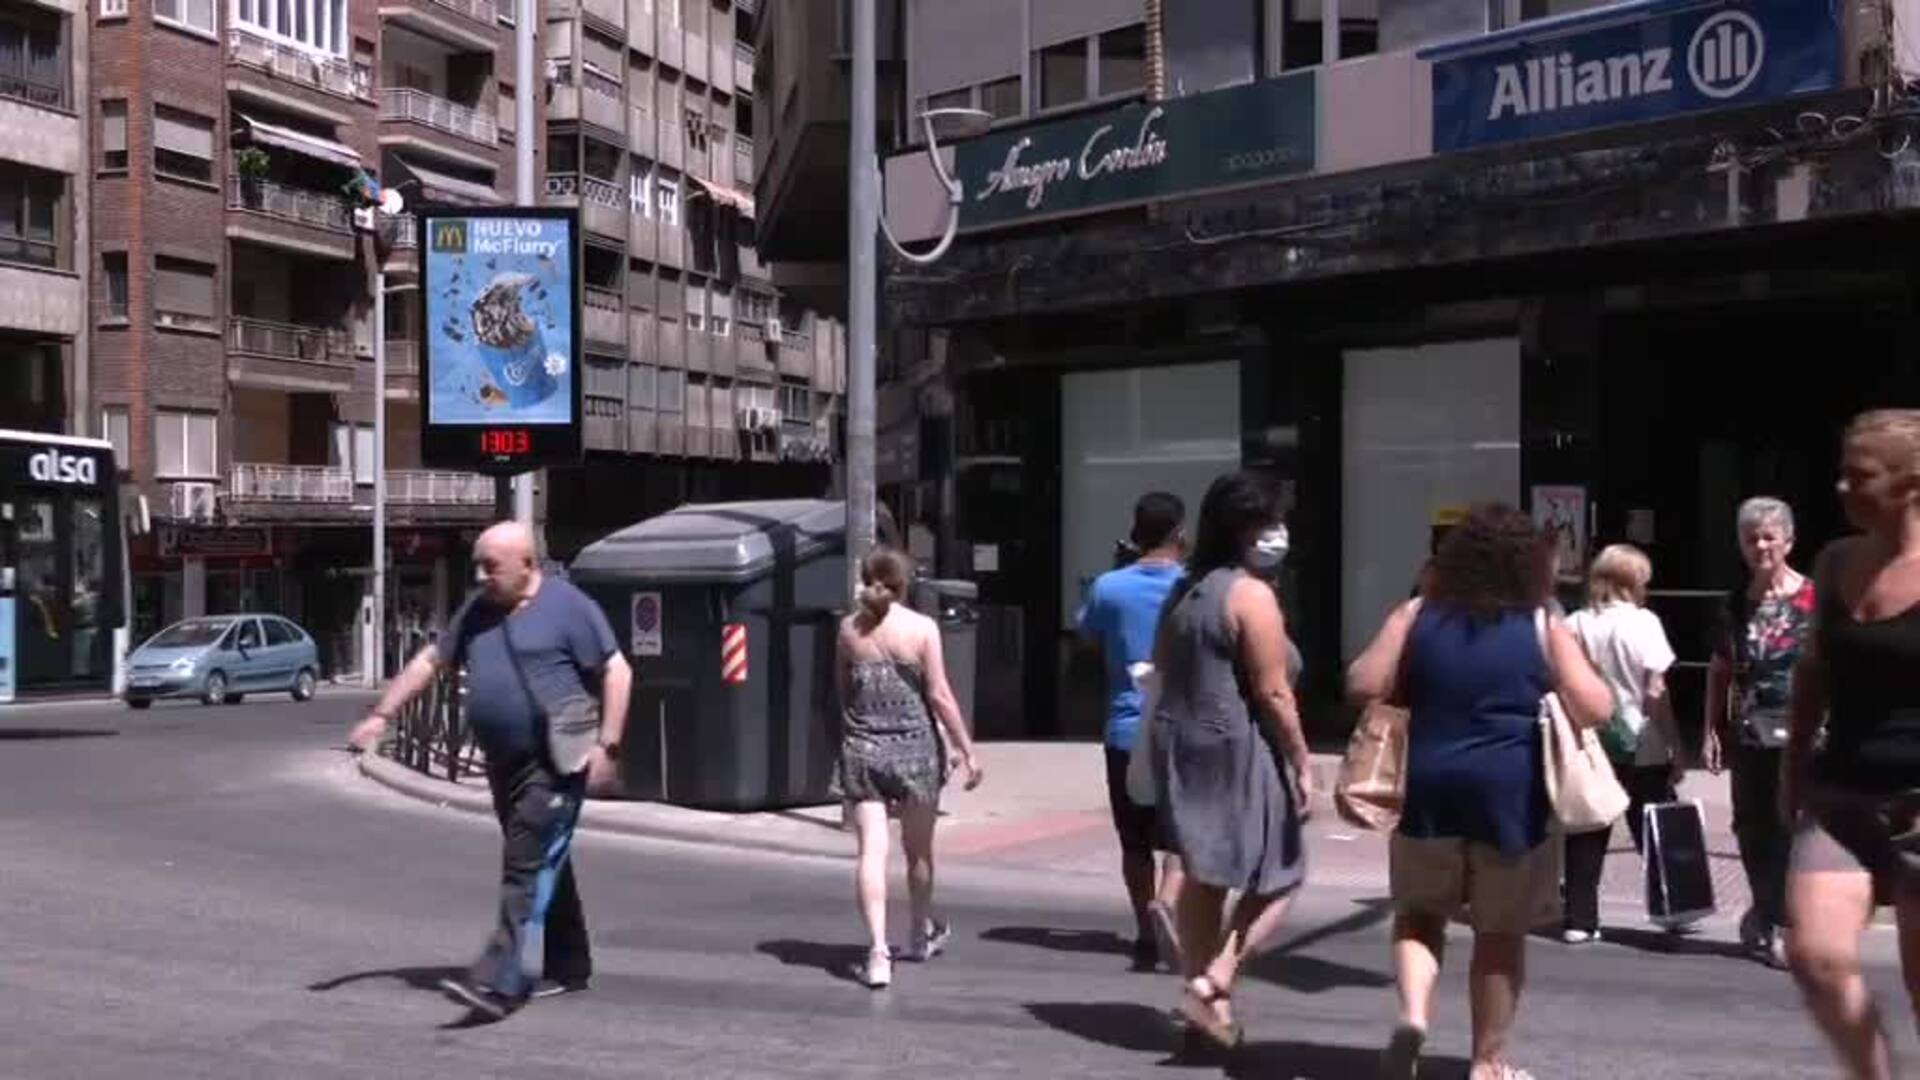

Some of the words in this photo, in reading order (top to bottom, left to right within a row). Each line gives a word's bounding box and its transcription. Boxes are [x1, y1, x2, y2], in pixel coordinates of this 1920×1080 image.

[1487, 48, 1674, 121] Allianz
[474, 220, 543, 237] NUEVO
[29, 449, 96, 485] alsa
